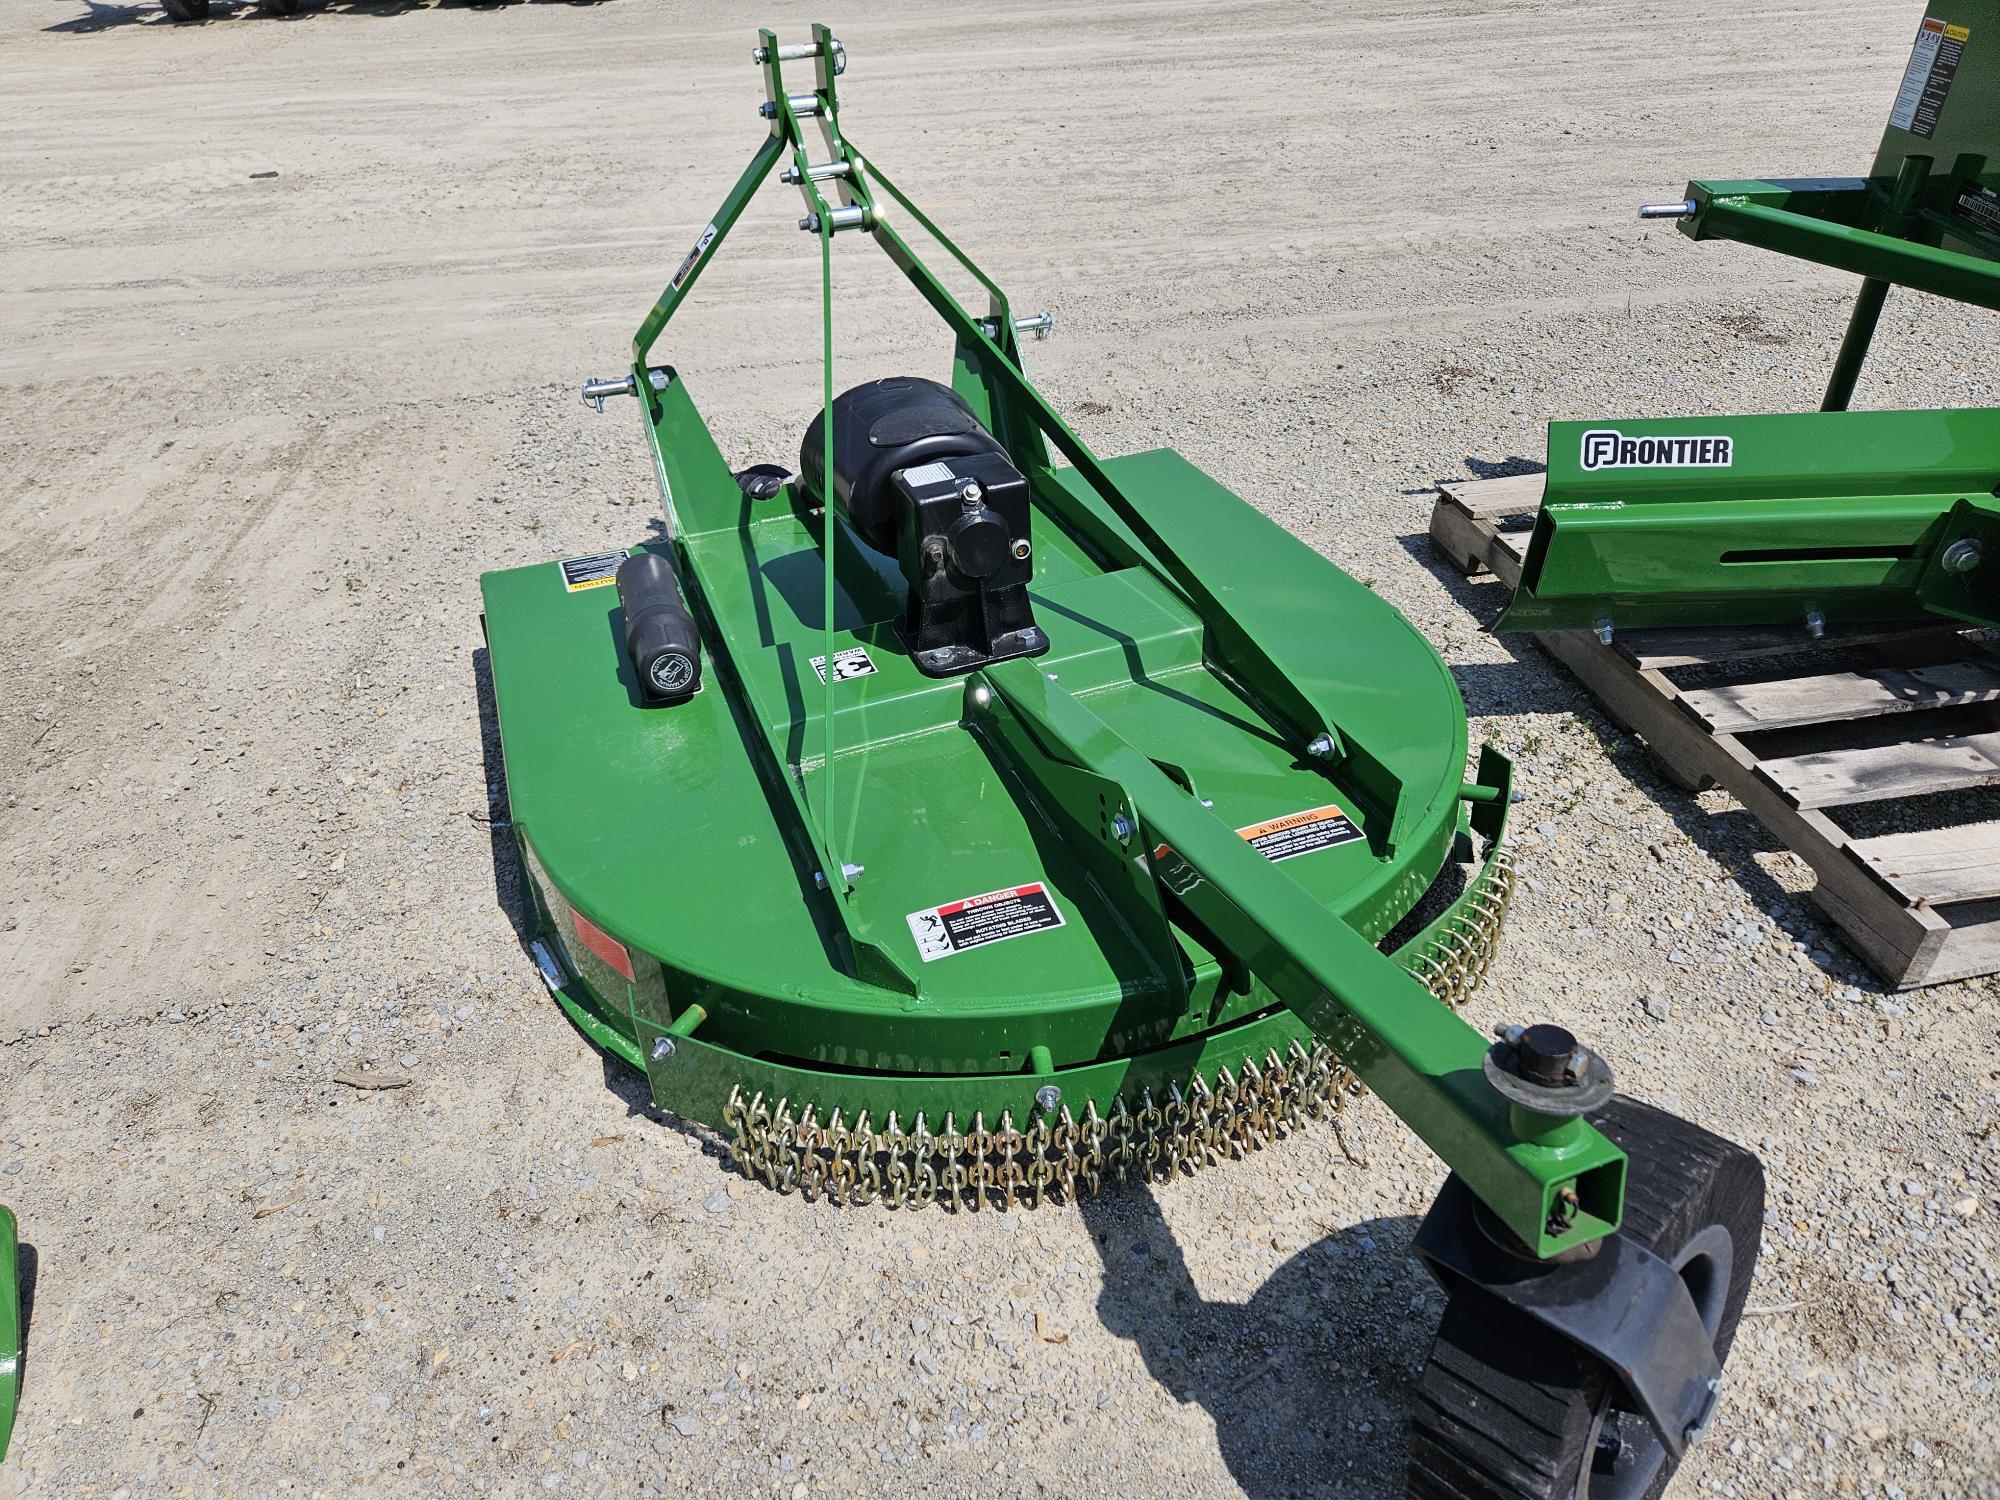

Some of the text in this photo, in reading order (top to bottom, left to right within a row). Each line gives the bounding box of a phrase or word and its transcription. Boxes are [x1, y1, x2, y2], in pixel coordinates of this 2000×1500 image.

[1584, 434, 1729, 467] FRONTIER
[574, 577, 615, 589] AUTION
[1269, 814, 1318, 829] WARNING
[974, 890, 1018, 905] DANGER
[967, 898, 1021, 914] THROWN OBJECTS
[975, 916, 1032, 934] ROTATING BLADES
